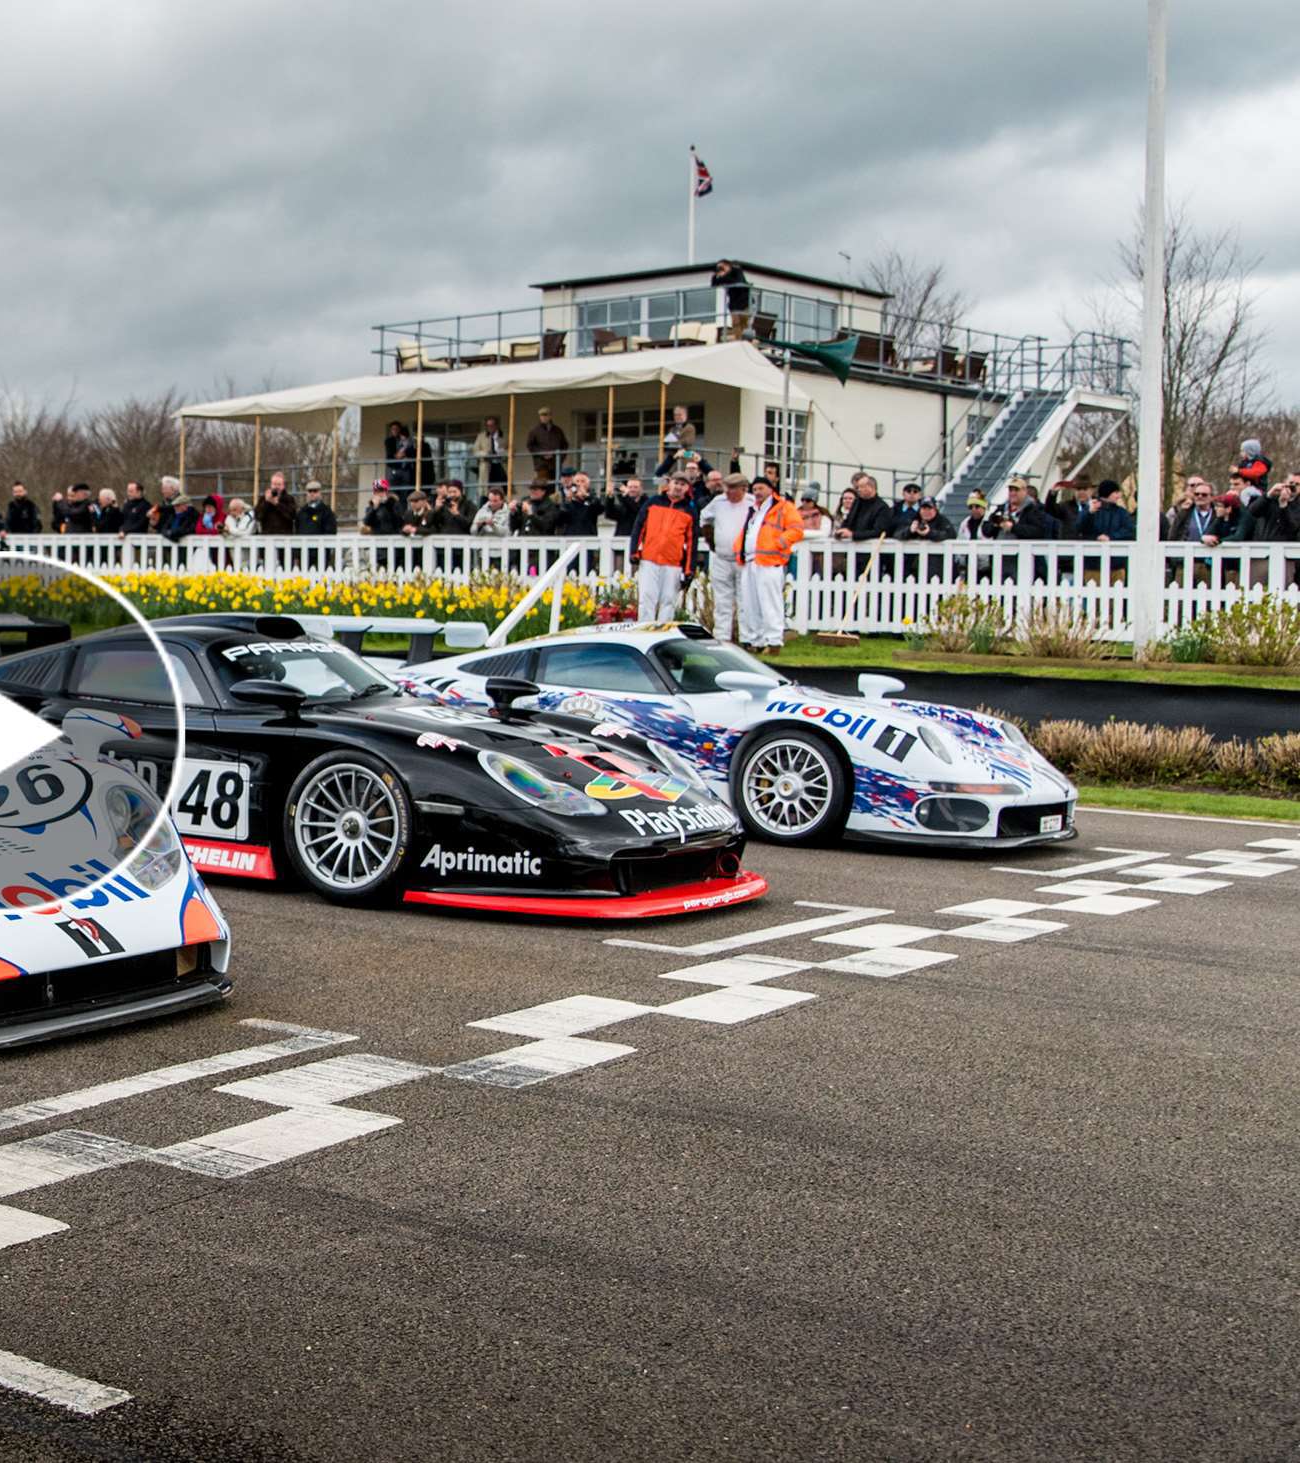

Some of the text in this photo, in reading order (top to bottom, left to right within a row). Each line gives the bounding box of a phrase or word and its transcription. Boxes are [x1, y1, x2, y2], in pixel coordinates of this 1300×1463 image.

[222, 642, 345, 662] PARAG
[765, 701, 877, 742] Mobil
[177, 769, 244, 830] 48
[618, 802, 736, 844] PlayStation
[185, 845, 257, 871] CHELIN
[420, 844, 542, 877] Aprimatic
